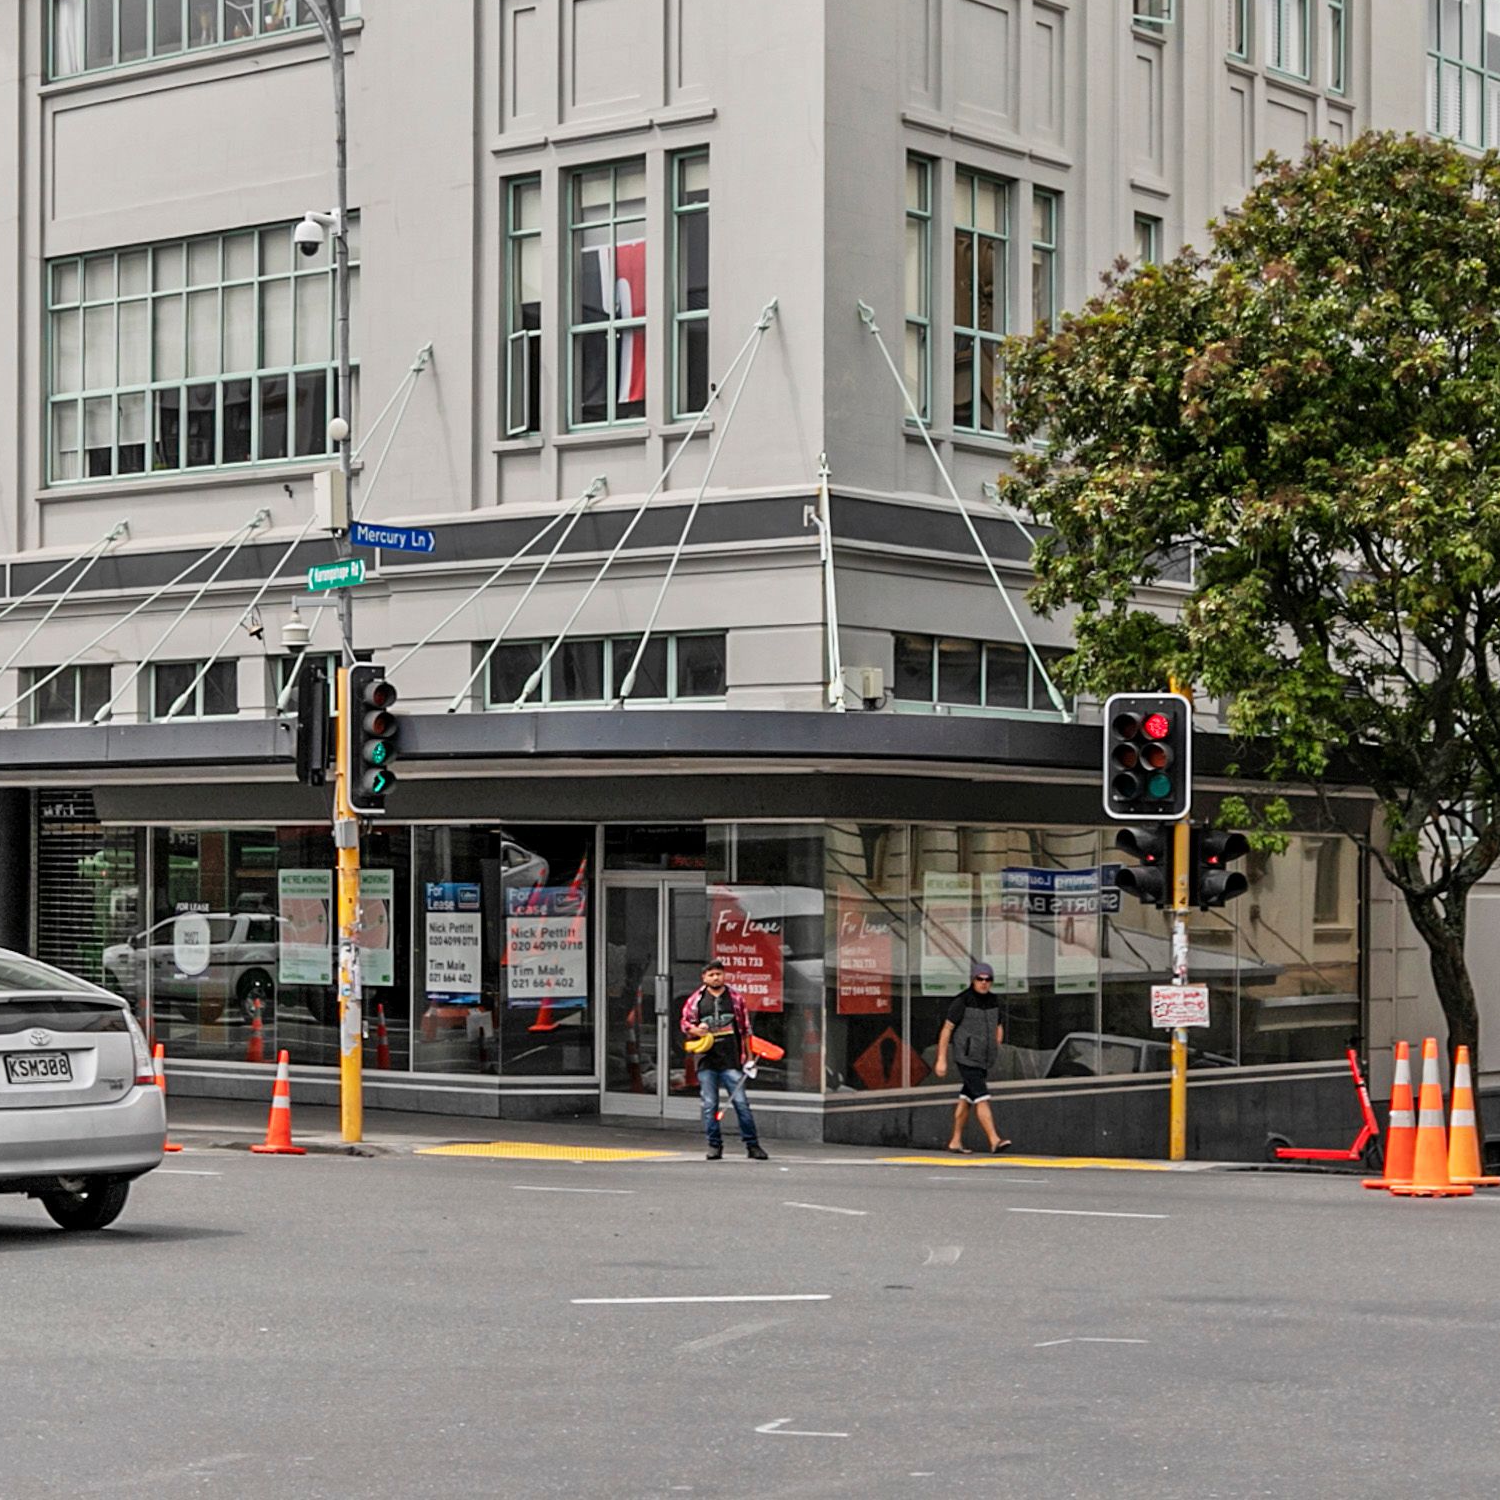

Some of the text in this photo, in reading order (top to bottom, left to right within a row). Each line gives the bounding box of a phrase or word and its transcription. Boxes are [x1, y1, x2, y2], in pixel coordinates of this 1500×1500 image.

[357, 525, 426, 549] Mercury Ln
[427, 883, 443, 897] For
[509, 888, 530, 901] For
[175, 902, 209, 912] FOR LEASE
[427, 898, 455, 911] Lease
[509, 903, 548, 916] Lease
[429, 923, 474, 933] Nick Pettitt
[716, 909, 781, 938] For Lease
[841, 911, 890, 939] For Lease
[511, 927, 576, 939] Nick Pettitt
[429, 936, 443, 946] 020
[511, 941, 584, 951] 020 4099 0718
[716, 943, 757, 954] Nilesh Patel
[429, 960, 466, 971] Tim Male
[733, 956, 748, 967] 761
[749, 956, 764, 967] 733
[511, 965, 566, 976] Tim Male
[429, 973, 441, 982] 021
[511, 978, 575, 989] 021 664 402
[8, 1058, 69, 1077] KSM308
